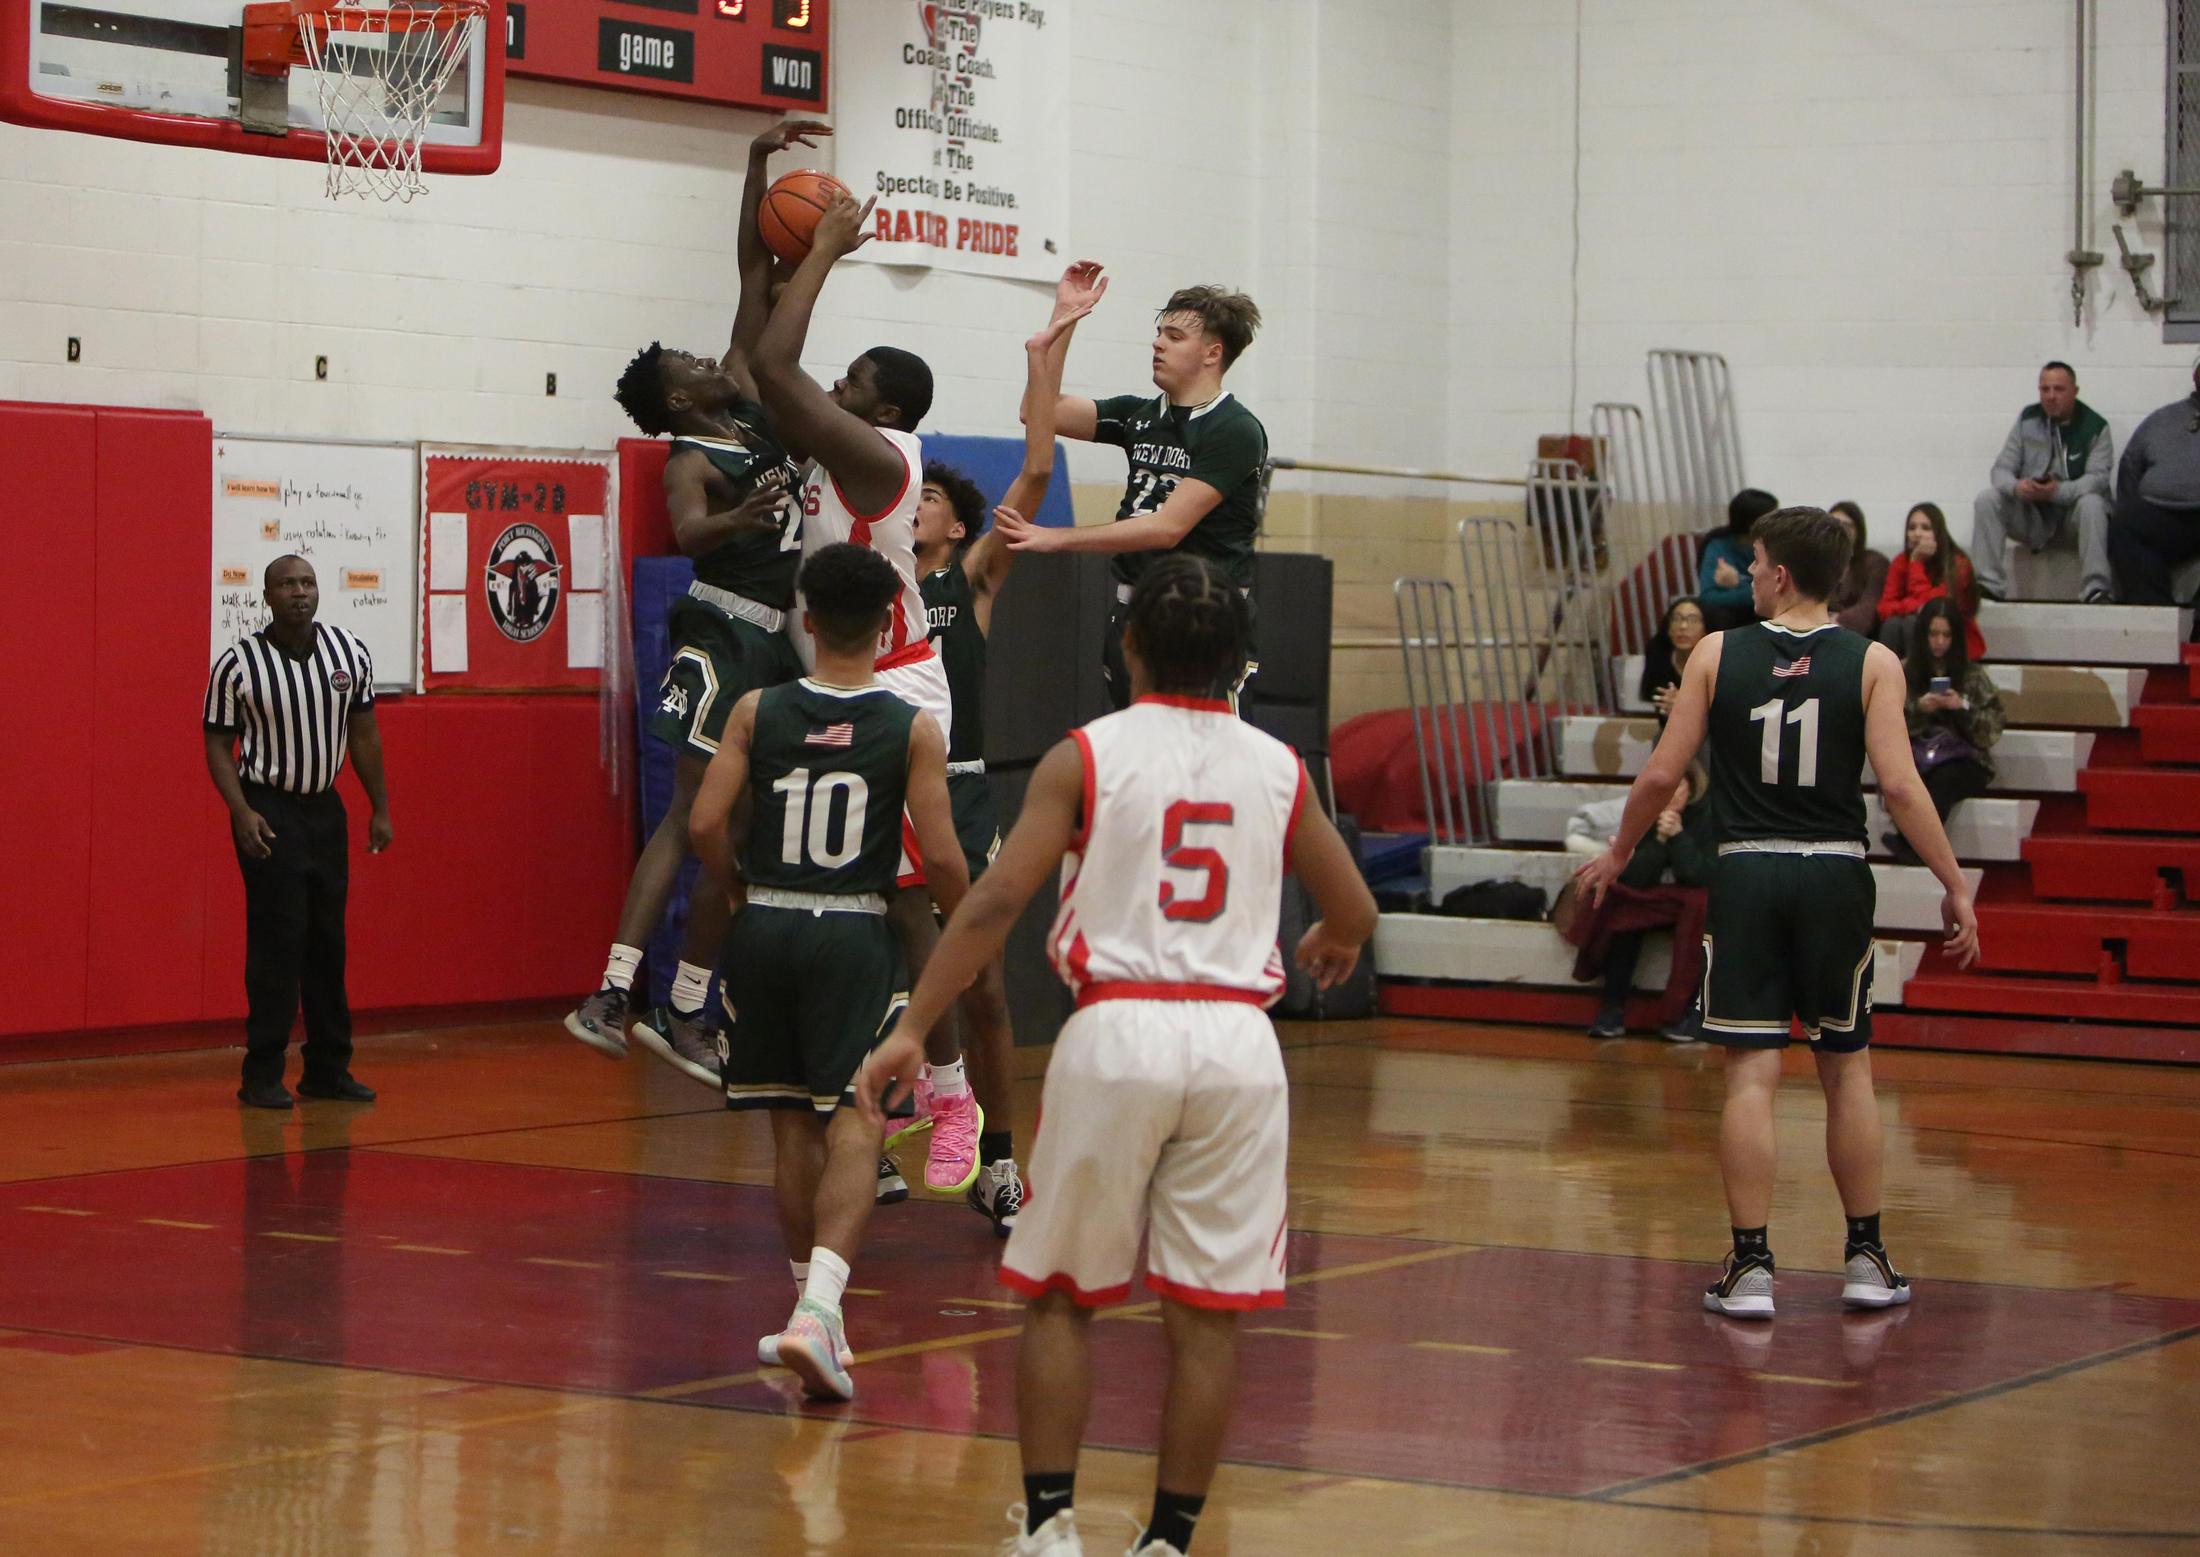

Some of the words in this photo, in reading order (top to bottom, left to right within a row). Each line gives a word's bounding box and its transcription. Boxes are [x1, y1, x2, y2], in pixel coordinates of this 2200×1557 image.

[1019, 2, 1046, 30] Play.
[949, 19, 976, 43] The
[620, 32, 675, 71] game
[773, 56, 812, 90] won
[957, 53, 996, 79] Coach.
[948, 84, 975, 106] The
[948, 115, 1002, 143] Officiate.
[947, 147, 974, 170] The
[944, 179, 962, 201] Be
[967, 182, 1019, 209] Positive.
[956, 217, 1019, 257] PRIDE
[68, 337, 81, 362] D
[316, 355, 327, 380] C
[546, 372, 557, 397] B
[1131, 442, 1164, 465] NEW
[929, 606, 958, 628] ORP
[1750, 698, 1820, 787] 11
[773, 767, 869, 869] 10
[1159, 799, 1234, 923] 5
